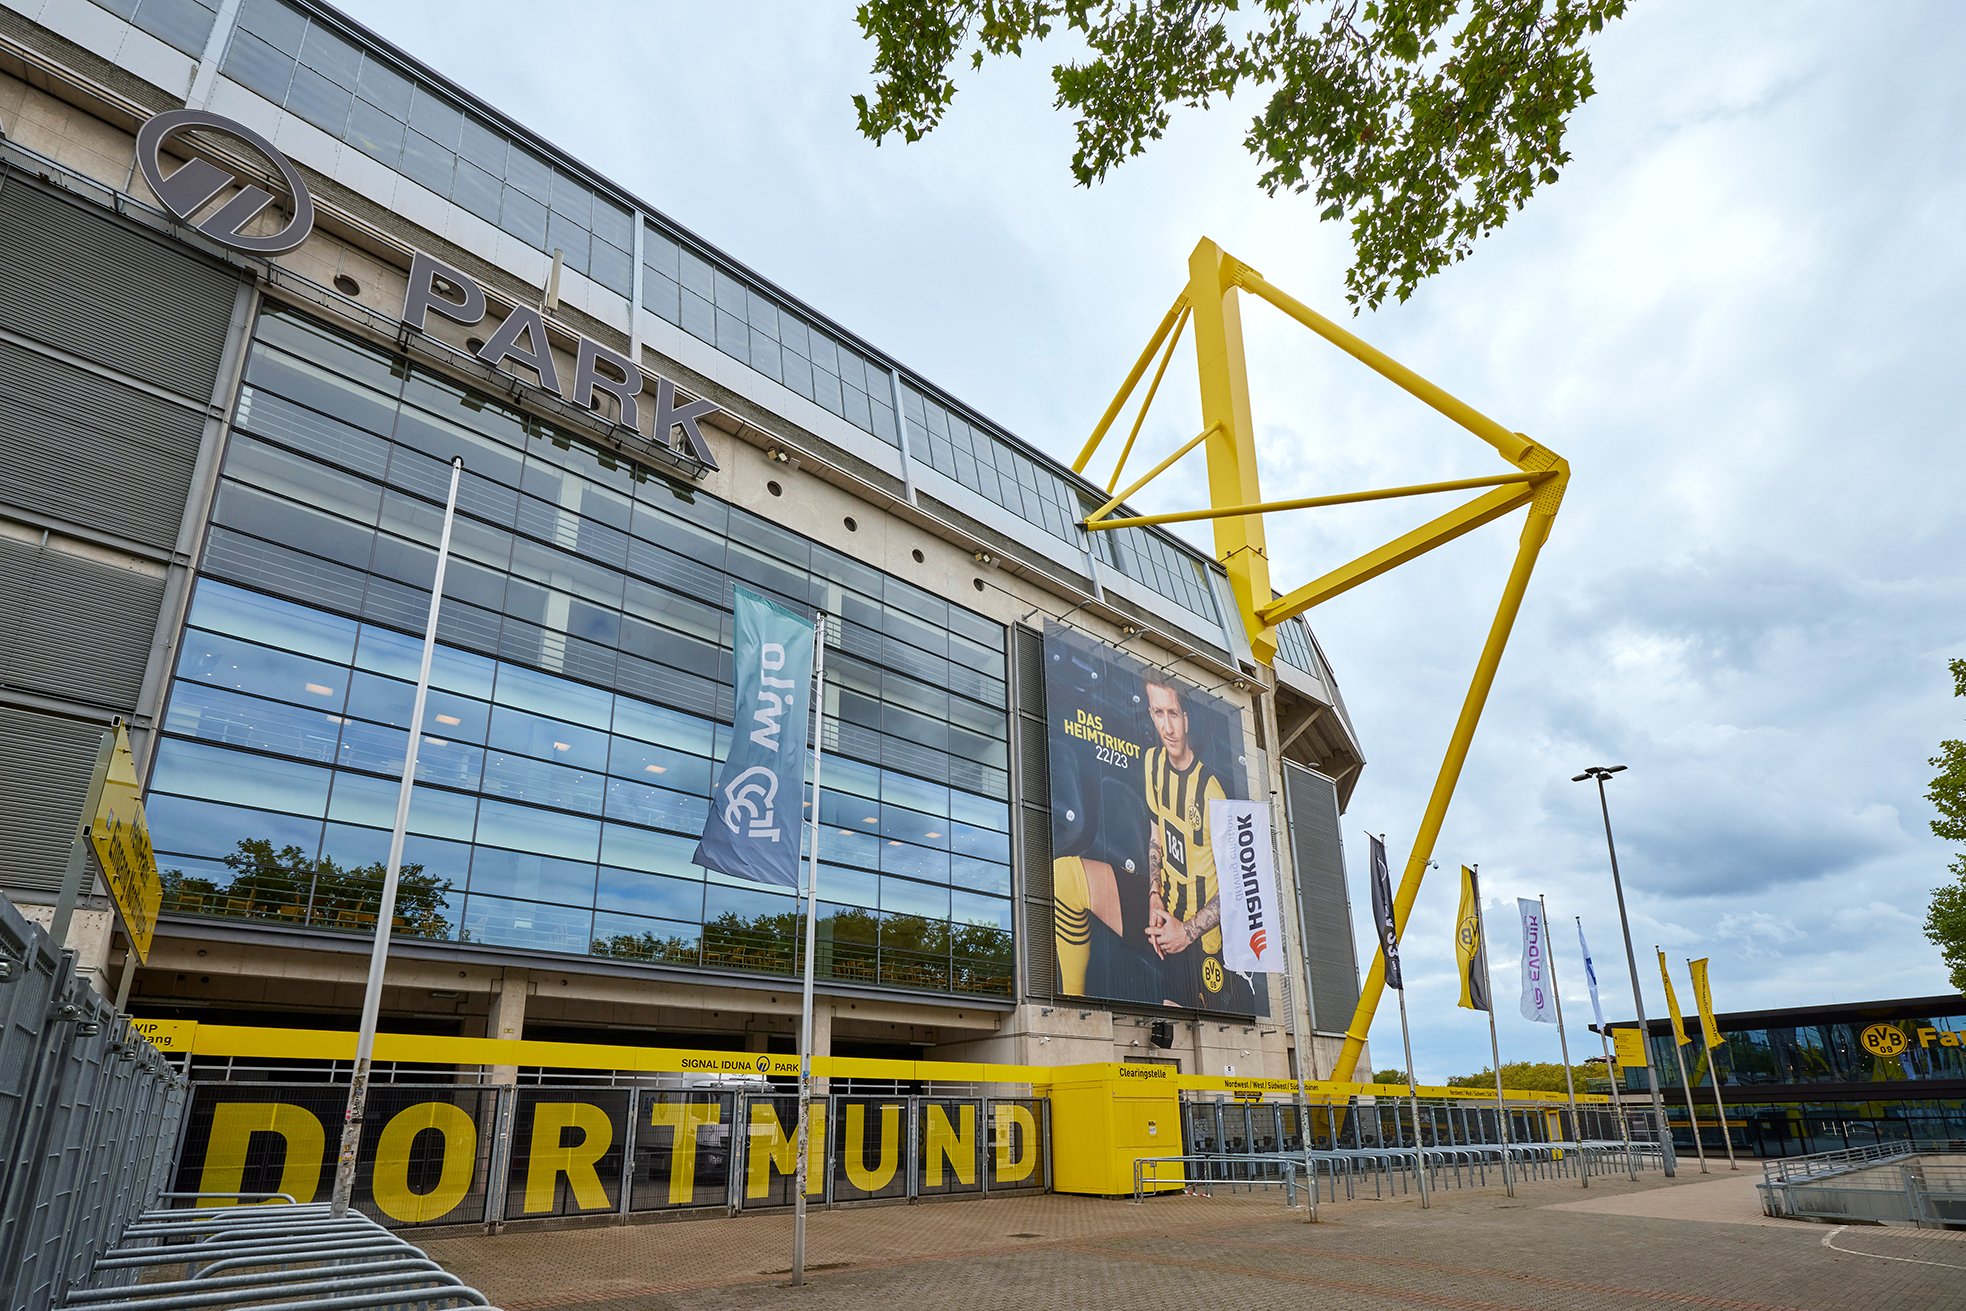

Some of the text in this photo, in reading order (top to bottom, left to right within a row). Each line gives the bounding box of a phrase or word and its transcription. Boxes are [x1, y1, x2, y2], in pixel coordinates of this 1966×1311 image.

[401, 251, 722, 472] PARK
[1076, 709, 1103, 730] DAS
[1064, 719, 1140, 759] HEIMTRIKOT
[1096, 746, 1128, 769] 22/23
[1166, 830, 1185, 865] 1&1
[1205, 961, 1221, 982] BVB
[134, 1024, 158, 1033] VIP
[1867, 1028, 1902, 1047] BVB
[1879, 1046, 1893, 1054] 09
[681, 1058, 799, 1072] SIGNAL IDUNA PARK
[1119, 1067, 1167, 1080] Clearingstelle
[1224, 1079, 1249, 1089] Nordwest
[1253, 1081, 1264, 1089] West
[191, 1101, 1037, 1232] DORTMUND
